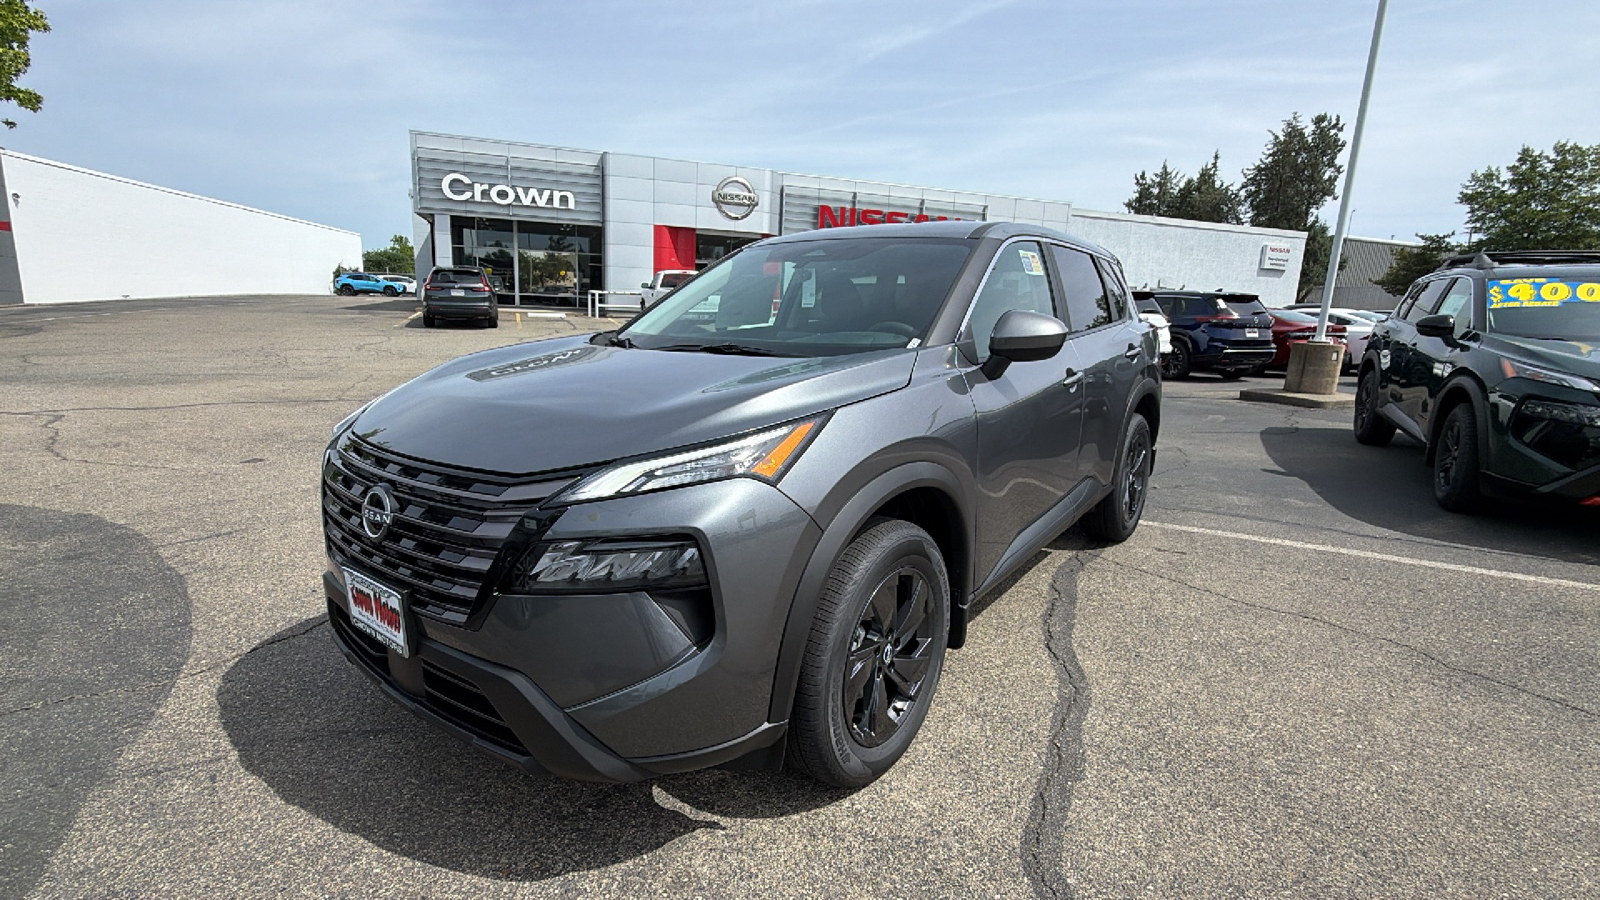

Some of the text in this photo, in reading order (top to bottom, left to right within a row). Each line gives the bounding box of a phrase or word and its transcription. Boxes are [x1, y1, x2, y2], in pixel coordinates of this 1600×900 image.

[441, 173, 575, 209] Crown
[717, 192, 756, 203] NISSAN
[819, 205, 961, 229] NISS
[1269, 246, 1290, 254] NISSAN
